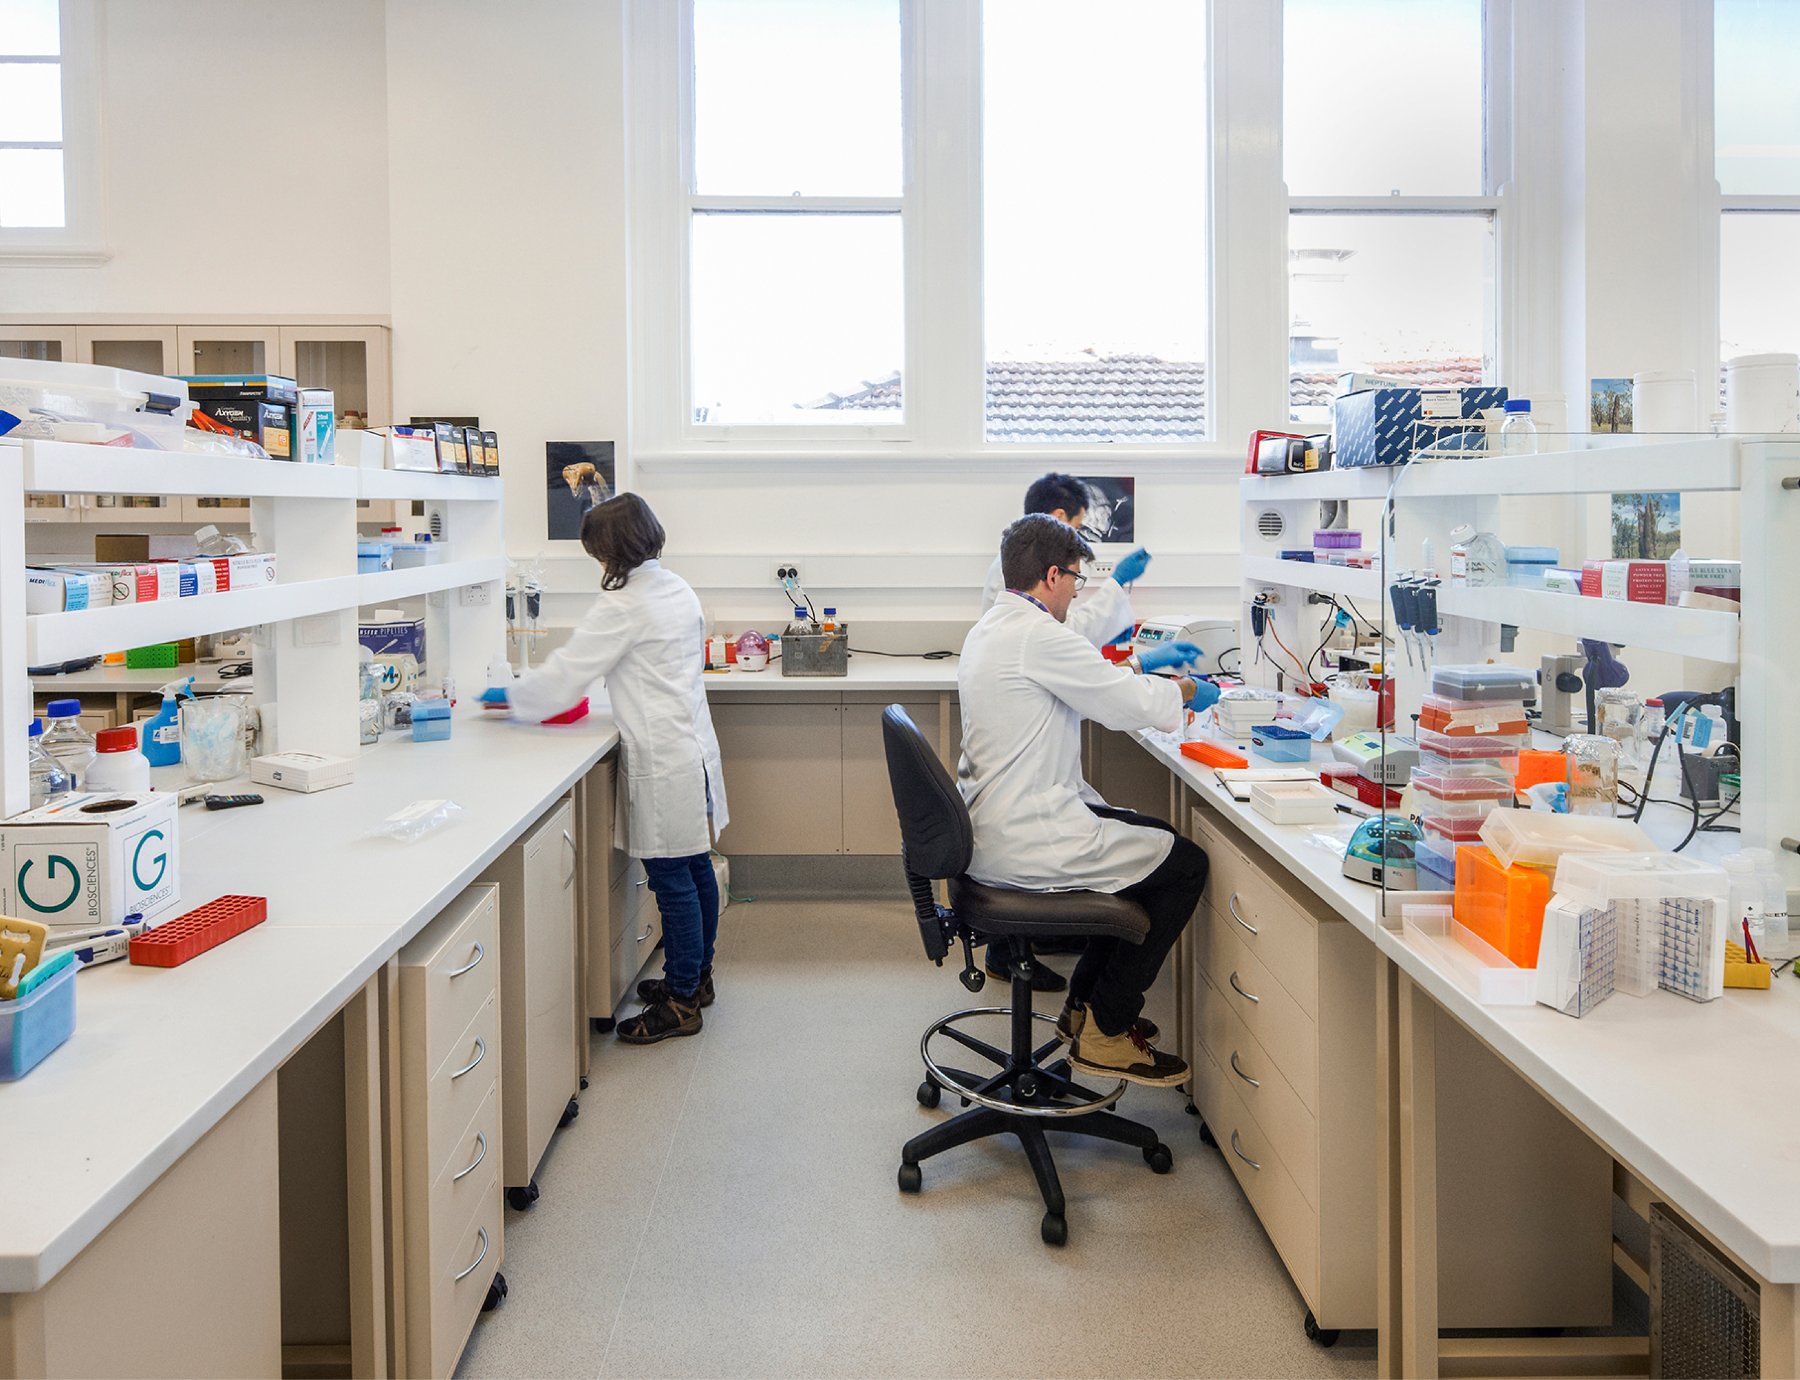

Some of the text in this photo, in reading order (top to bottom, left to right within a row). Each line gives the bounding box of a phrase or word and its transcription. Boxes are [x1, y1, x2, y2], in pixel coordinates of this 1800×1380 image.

[1365, 378, 1398, 387] NEPTUNE
[17, 854, 81, 914] G
[86, 849, 98, 917] BIOSCIENCES
[132, 829, 167, 892] G
[129, 886, 170, 915] BIOSCIENCES
